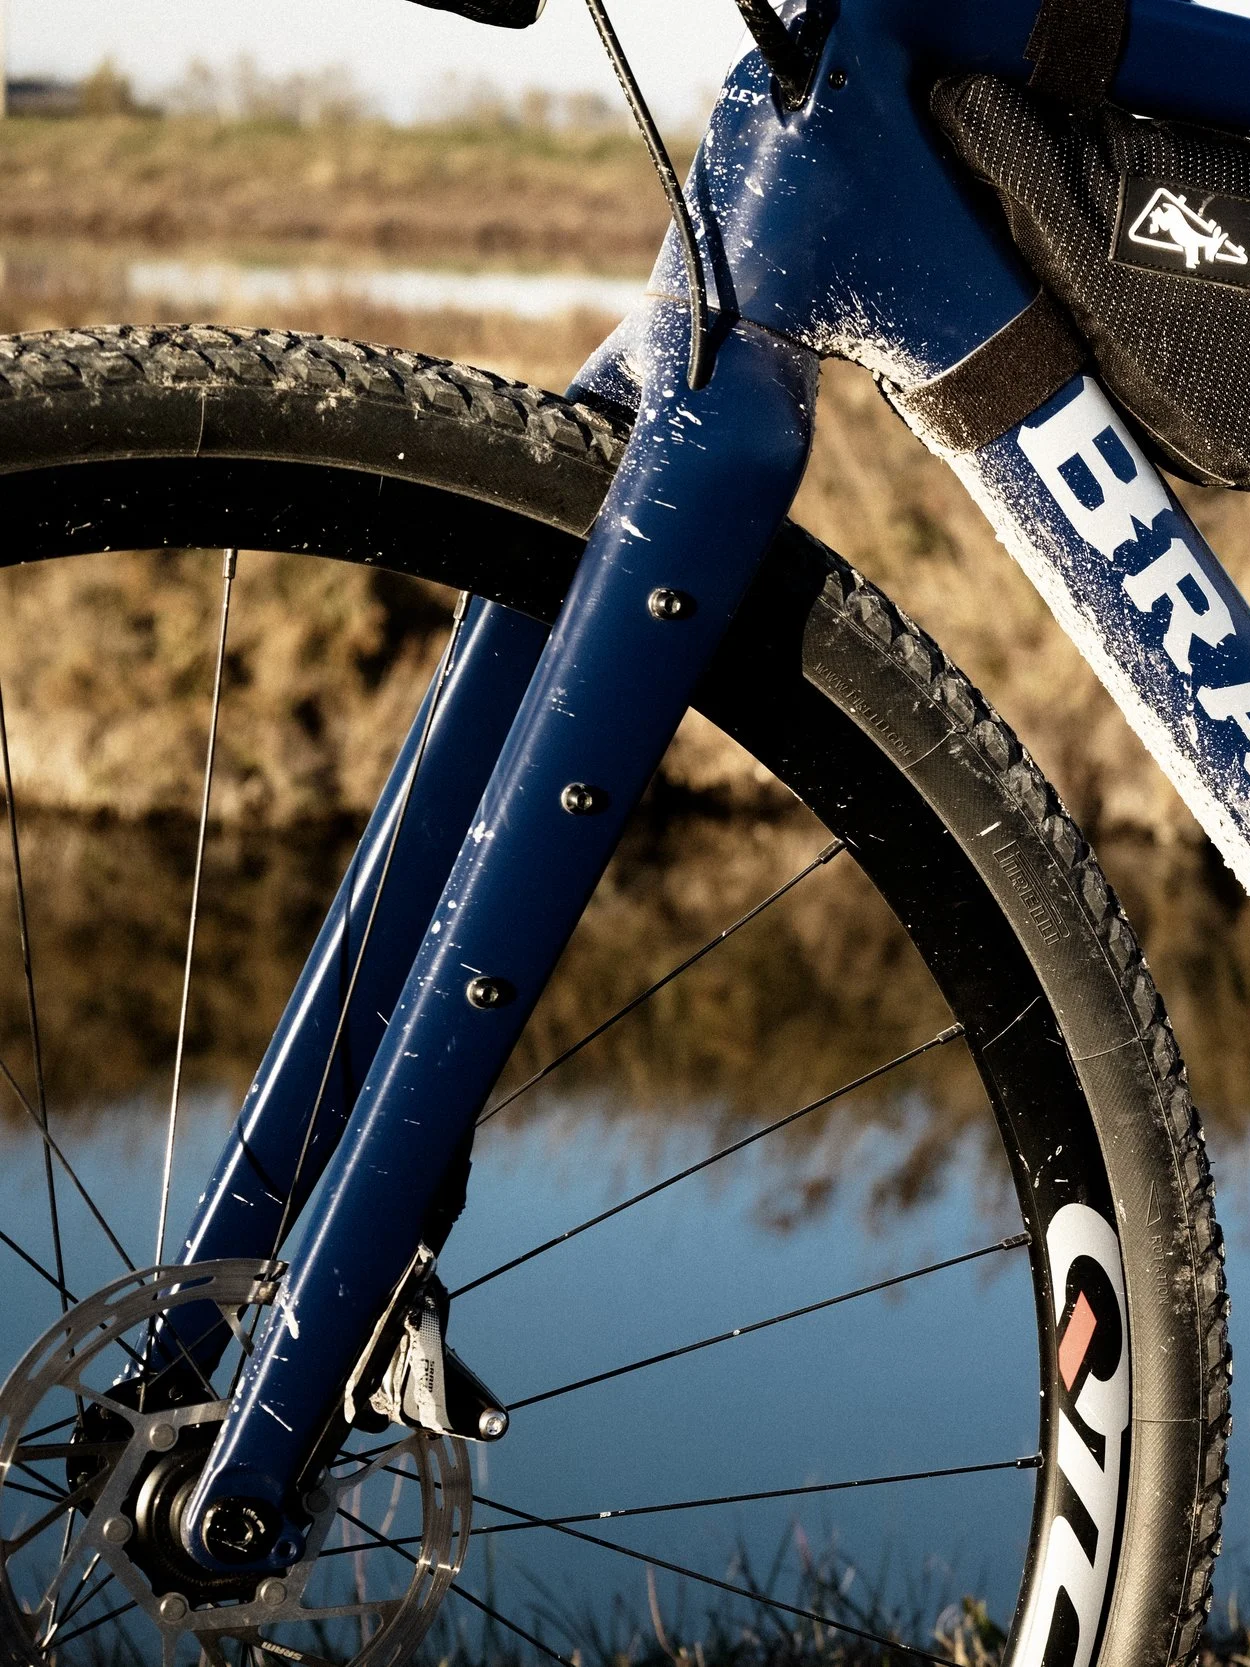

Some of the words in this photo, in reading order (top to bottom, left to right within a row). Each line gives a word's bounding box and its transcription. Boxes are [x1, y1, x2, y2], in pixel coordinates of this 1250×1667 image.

[992, 840, 1071, 946] PIRELLI
[1150, 1234, 1171, 1306] ROTATION
[261, 1641, 304, 1661] SRAM
